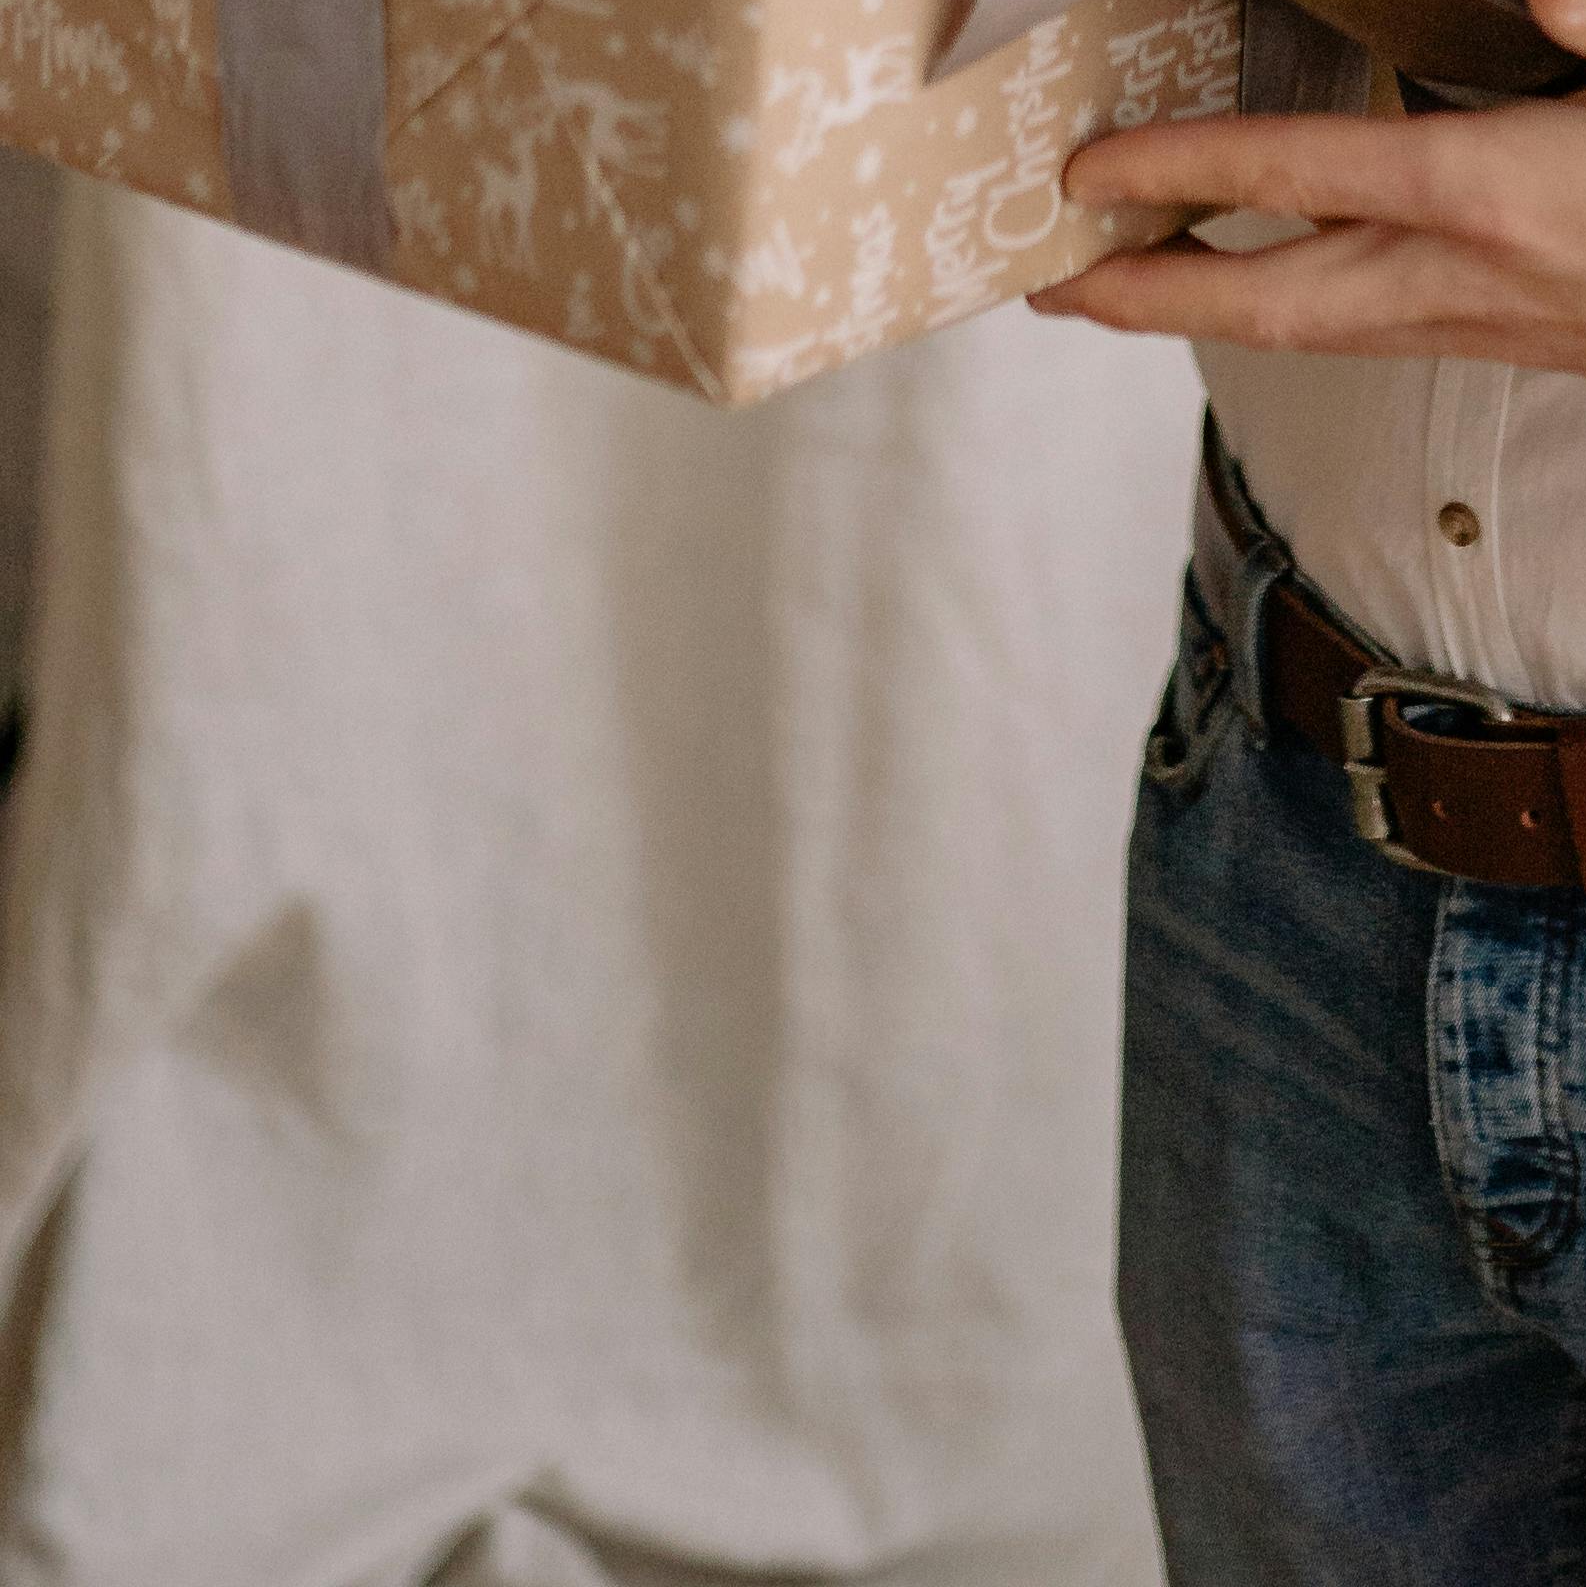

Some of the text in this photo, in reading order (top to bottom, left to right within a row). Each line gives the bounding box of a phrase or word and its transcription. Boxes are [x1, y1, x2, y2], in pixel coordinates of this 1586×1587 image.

[982, 13, 1075, 252] Christm
[1107, 17, 1178, 129] erry
[922, 157, 1011, 331] Merry
